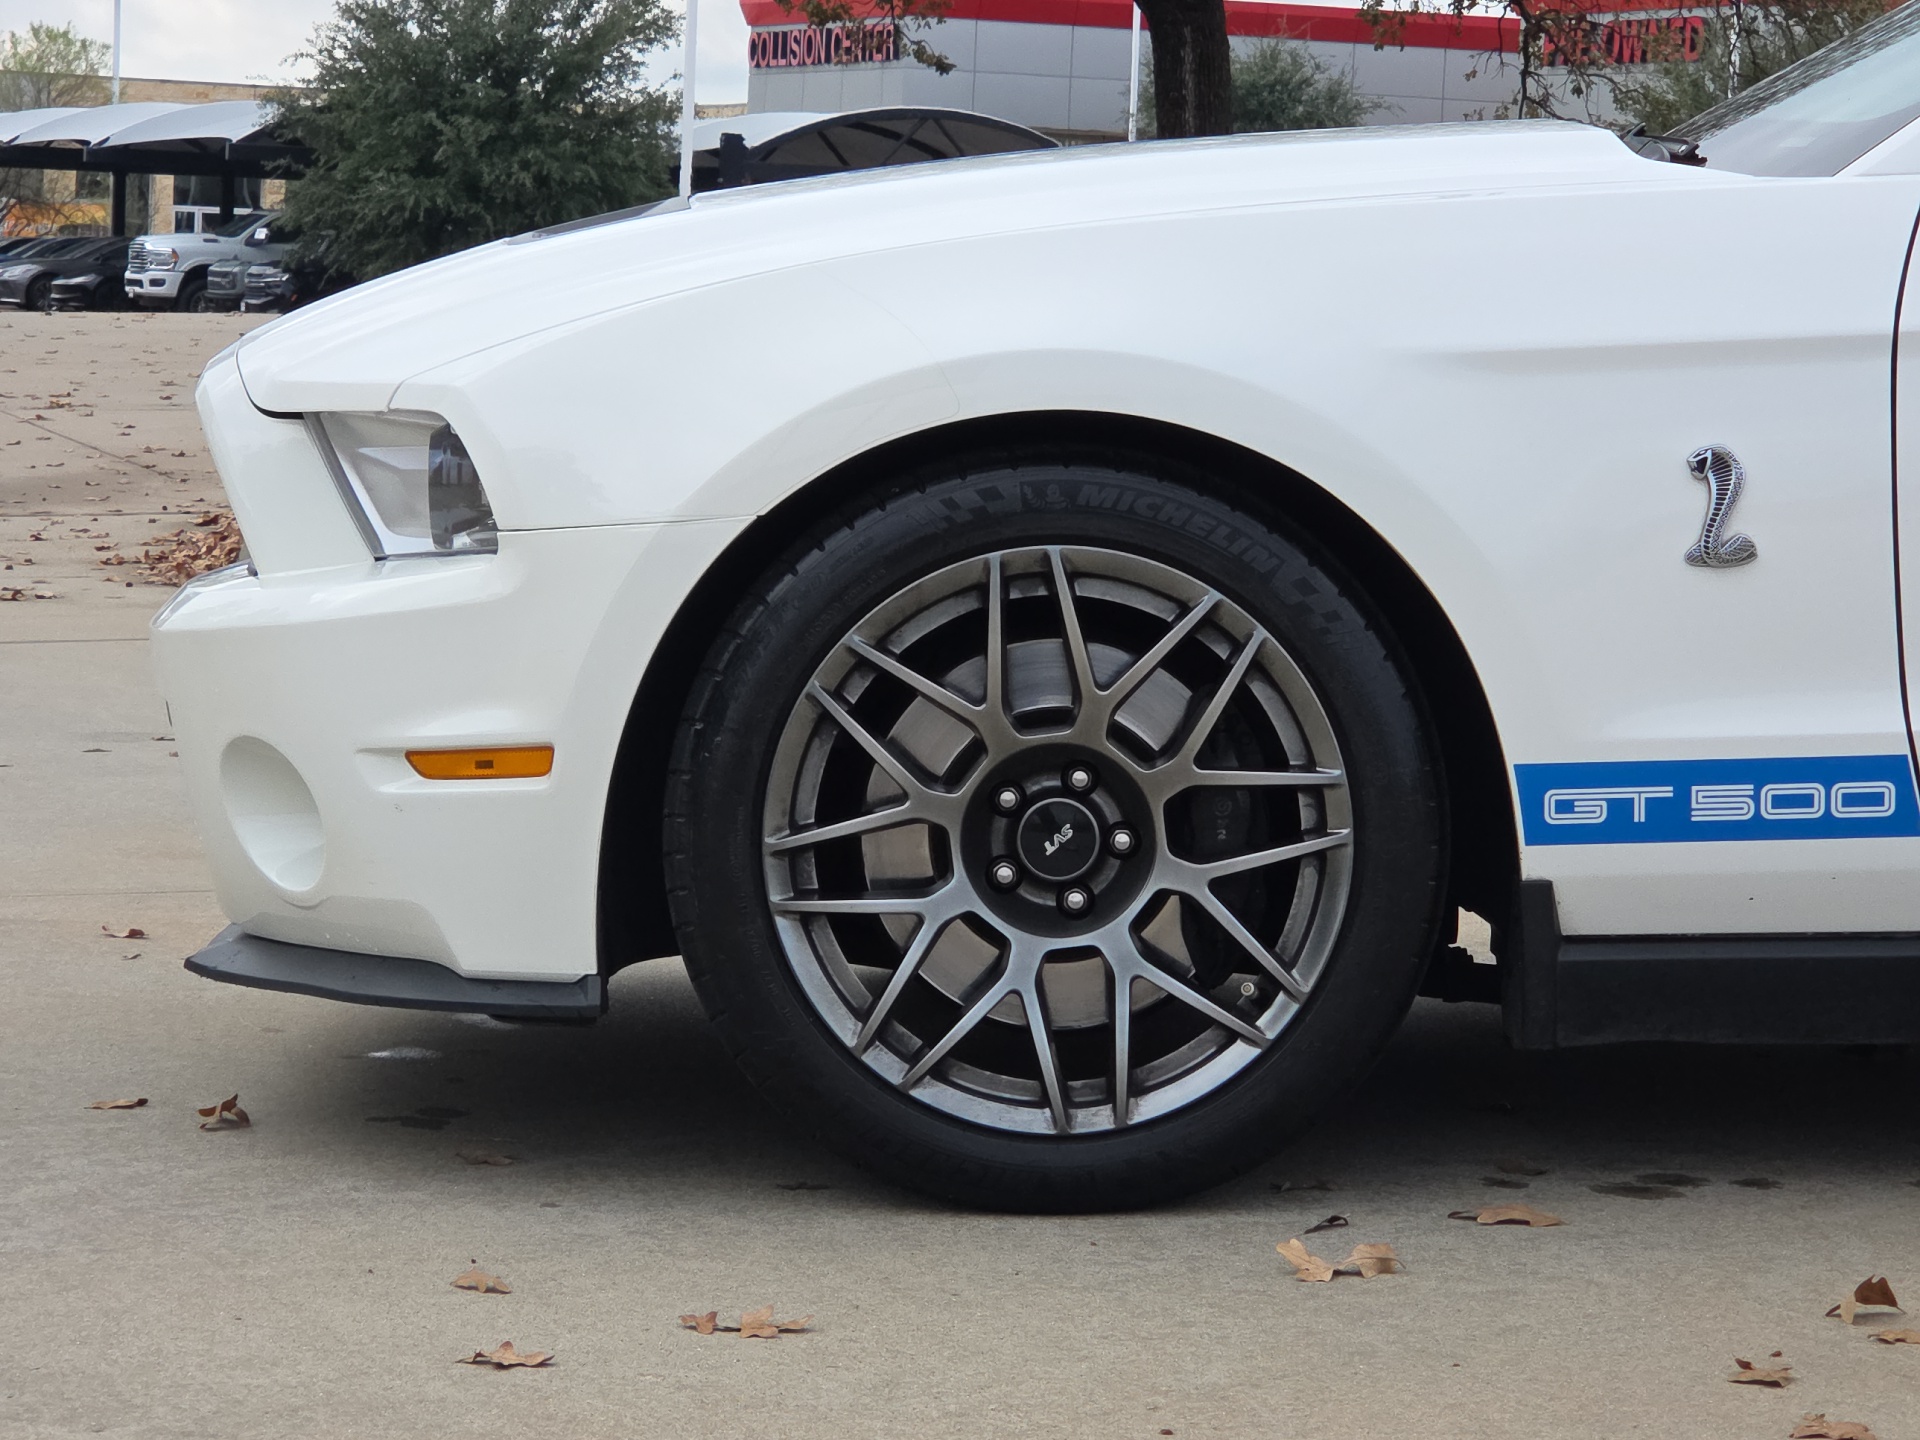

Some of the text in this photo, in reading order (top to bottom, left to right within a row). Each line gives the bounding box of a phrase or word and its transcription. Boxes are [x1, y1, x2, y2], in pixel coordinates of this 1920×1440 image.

[749, 26, 826, 68] COLLISION
[1075, 484, 1280, 574] MICHELIN
[1544, 781, 1895, 825] GT 500
[1044, 823, 1073, 856] SVT
